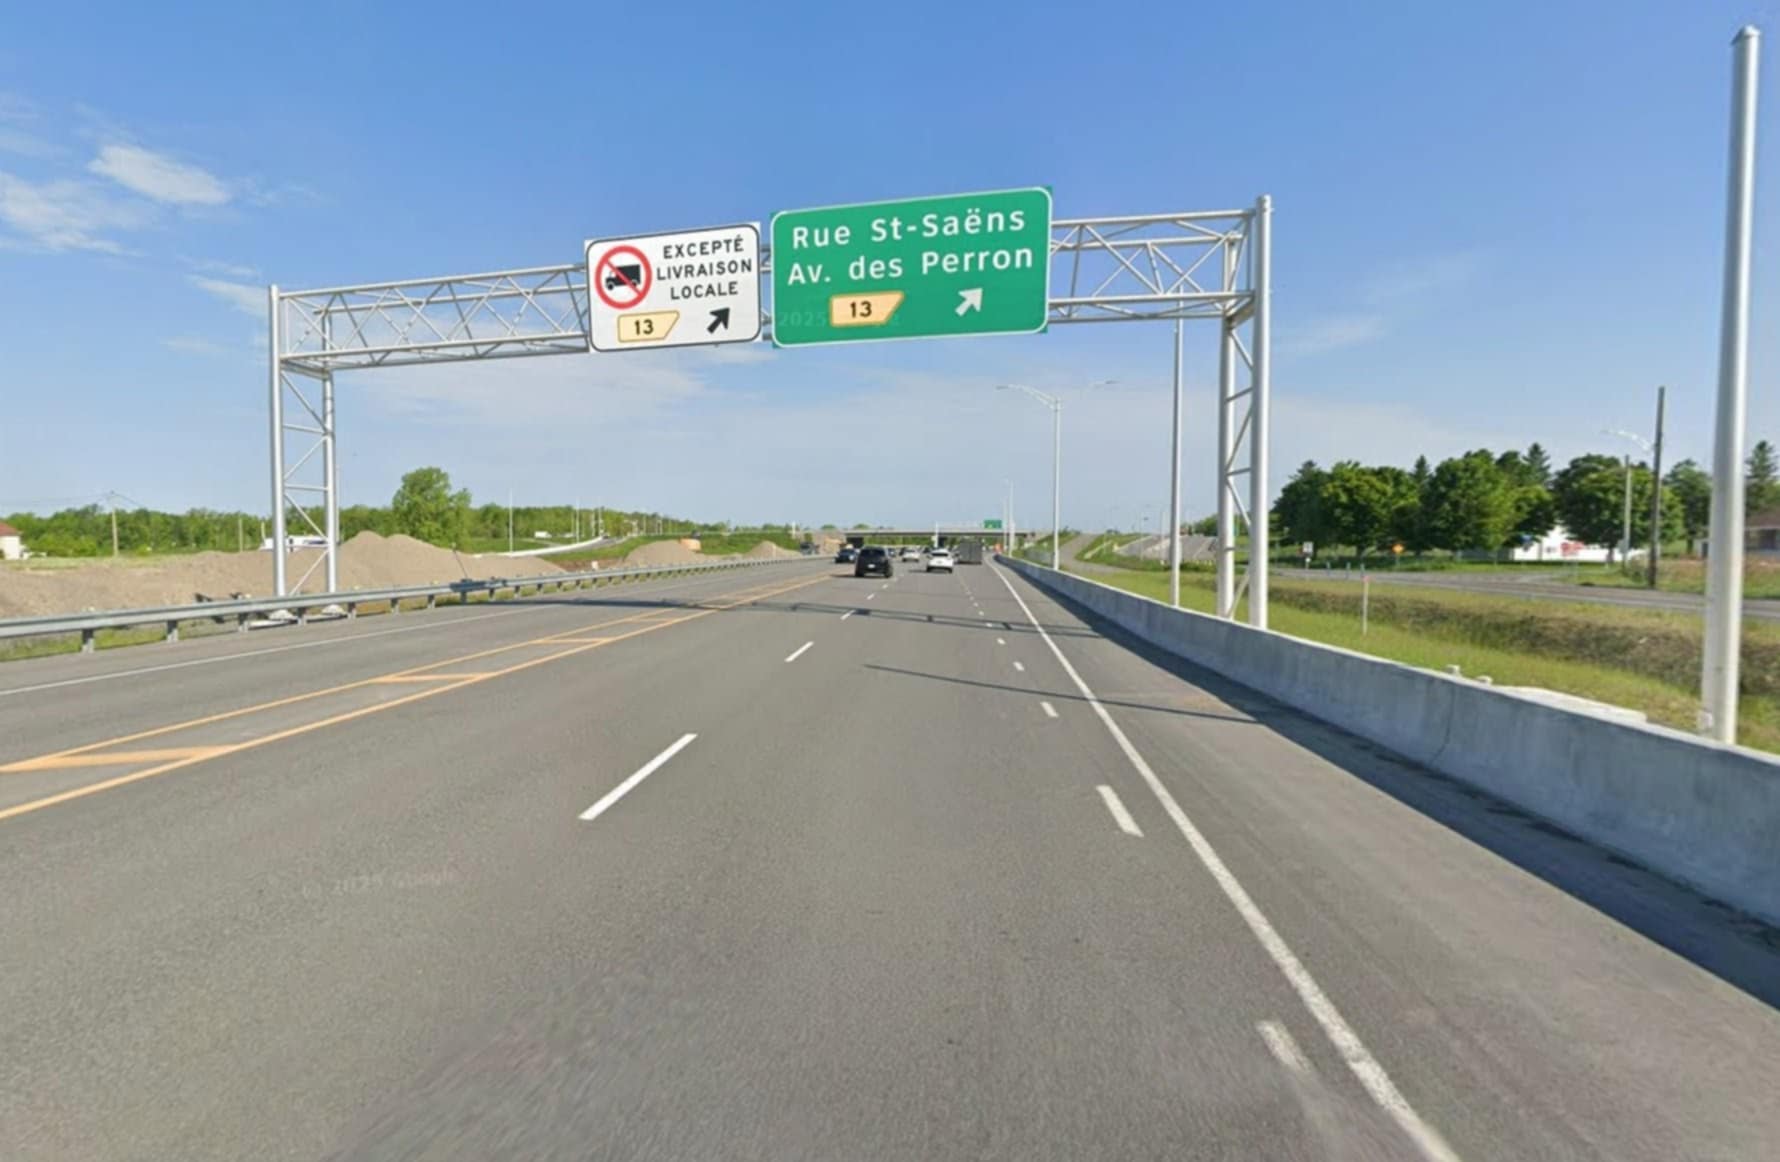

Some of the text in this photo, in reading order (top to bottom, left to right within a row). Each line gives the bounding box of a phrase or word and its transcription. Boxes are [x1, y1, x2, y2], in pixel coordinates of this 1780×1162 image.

[792, 208, 1026, 249] Rue St-Saëns
[662, 237, 744, 259] EXCEPTÉ
[656, 258, 753, 281] LIVRAISON
[787, 248, 1034, 285] Av. des Perron
[670, 281, 738, 300] LOCALE
[849, 300, 873, 319] 13
[634, 319, 655, 336] 13
